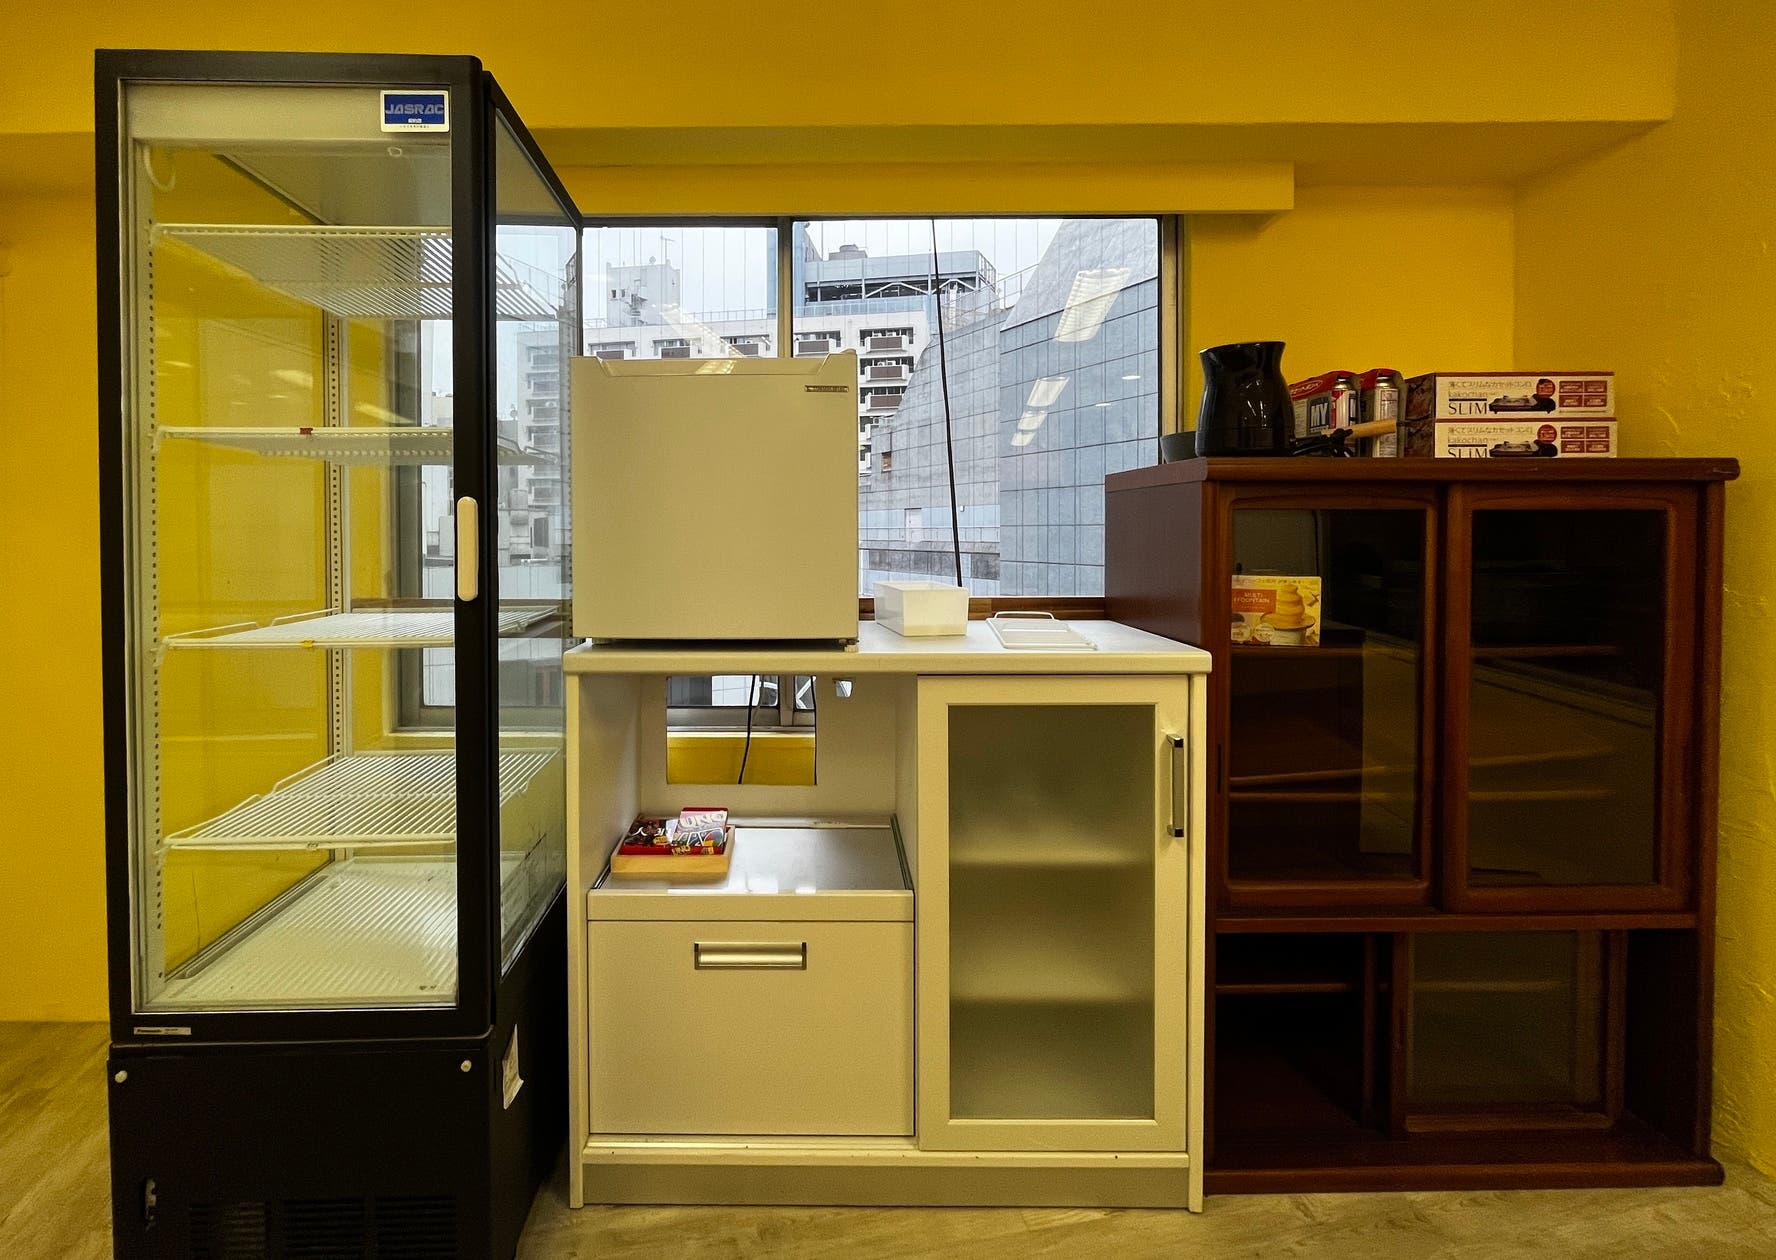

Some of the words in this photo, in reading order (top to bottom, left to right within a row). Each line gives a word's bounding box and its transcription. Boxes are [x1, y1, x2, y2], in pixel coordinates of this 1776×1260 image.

[385, 104, 444, 114] JASRAC
[1310, 402, 1328, 428] MY
[1448, 402, 1487, 415] SLIM
[680, 812, 727, 829] UNO
